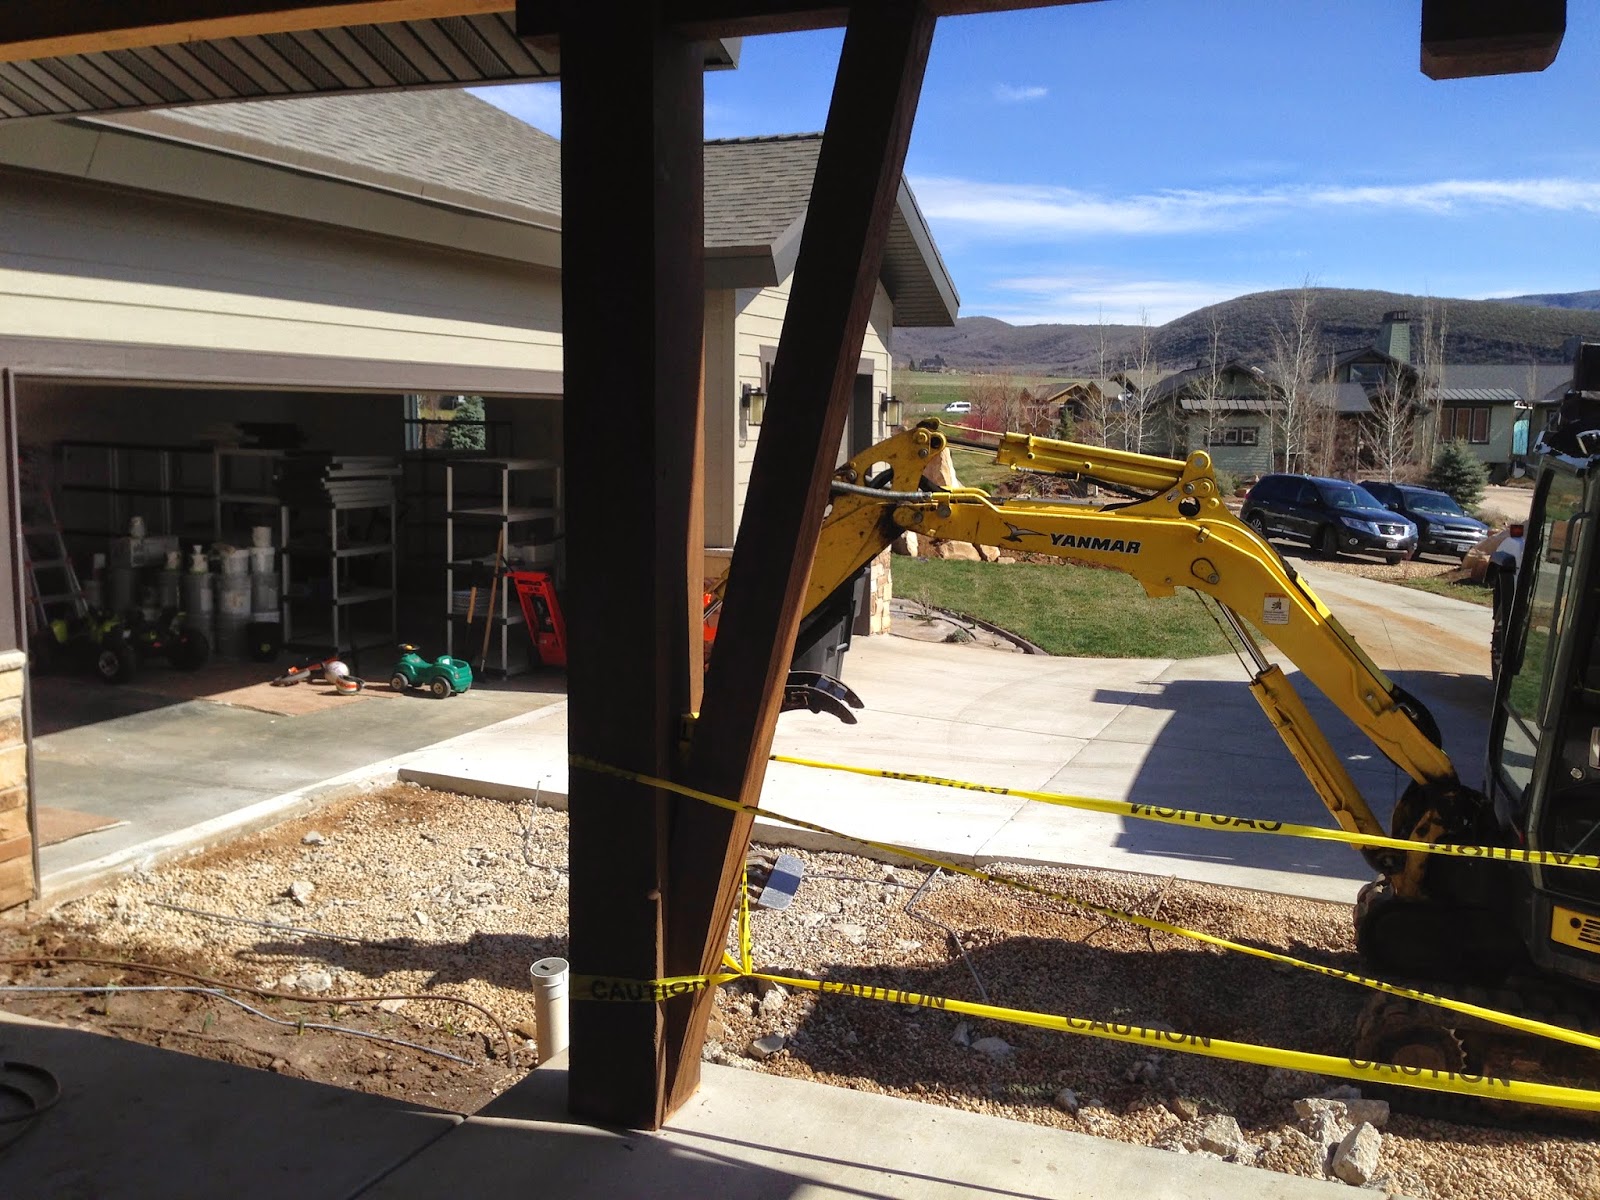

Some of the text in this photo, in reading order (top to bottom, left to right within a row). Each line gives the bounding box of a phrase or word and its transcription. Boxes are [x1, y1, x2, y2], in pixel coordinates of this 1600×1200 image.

[1050, 532, 1141, 554] YANMAR
[591, 979, 710, 1001] CAUTION
[819, 981, 945, 1008] CAUTION
